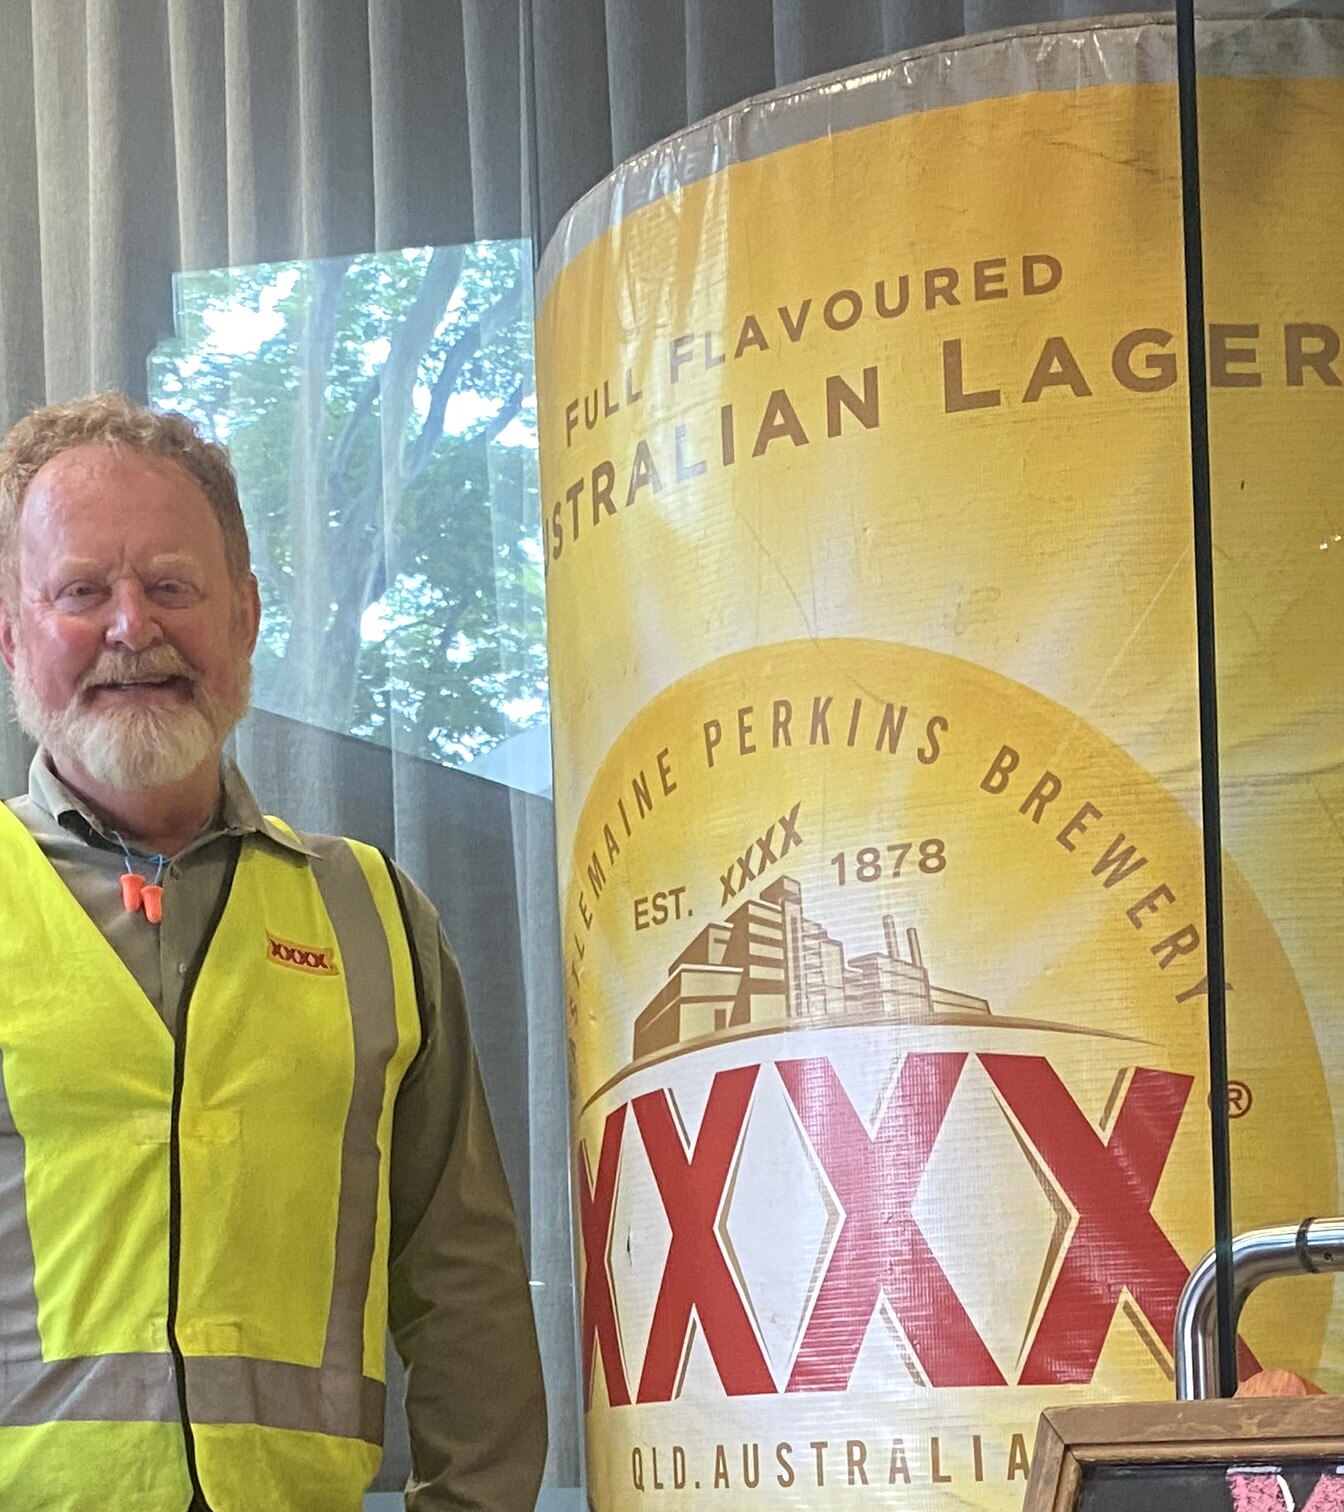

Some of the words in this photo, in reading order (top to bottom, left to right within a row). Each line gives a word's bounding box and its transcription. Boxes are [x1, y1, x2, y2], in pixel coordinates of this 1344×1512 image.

[565, 367, 643, 448] FULL
[668, 254, 1063, 385] FLAVOURED
[942, 323, 1343, 415] LAGER
[634, 886, 694, 931] EST.
[719, 803, 804, 908] XXXX
[829, 838, 948, 888] 1878
[702, 696, 949, 768] PERKINS
[979, 744, 1233, 1004] BREWERY
[268, 938, 329, 970] XXXX
